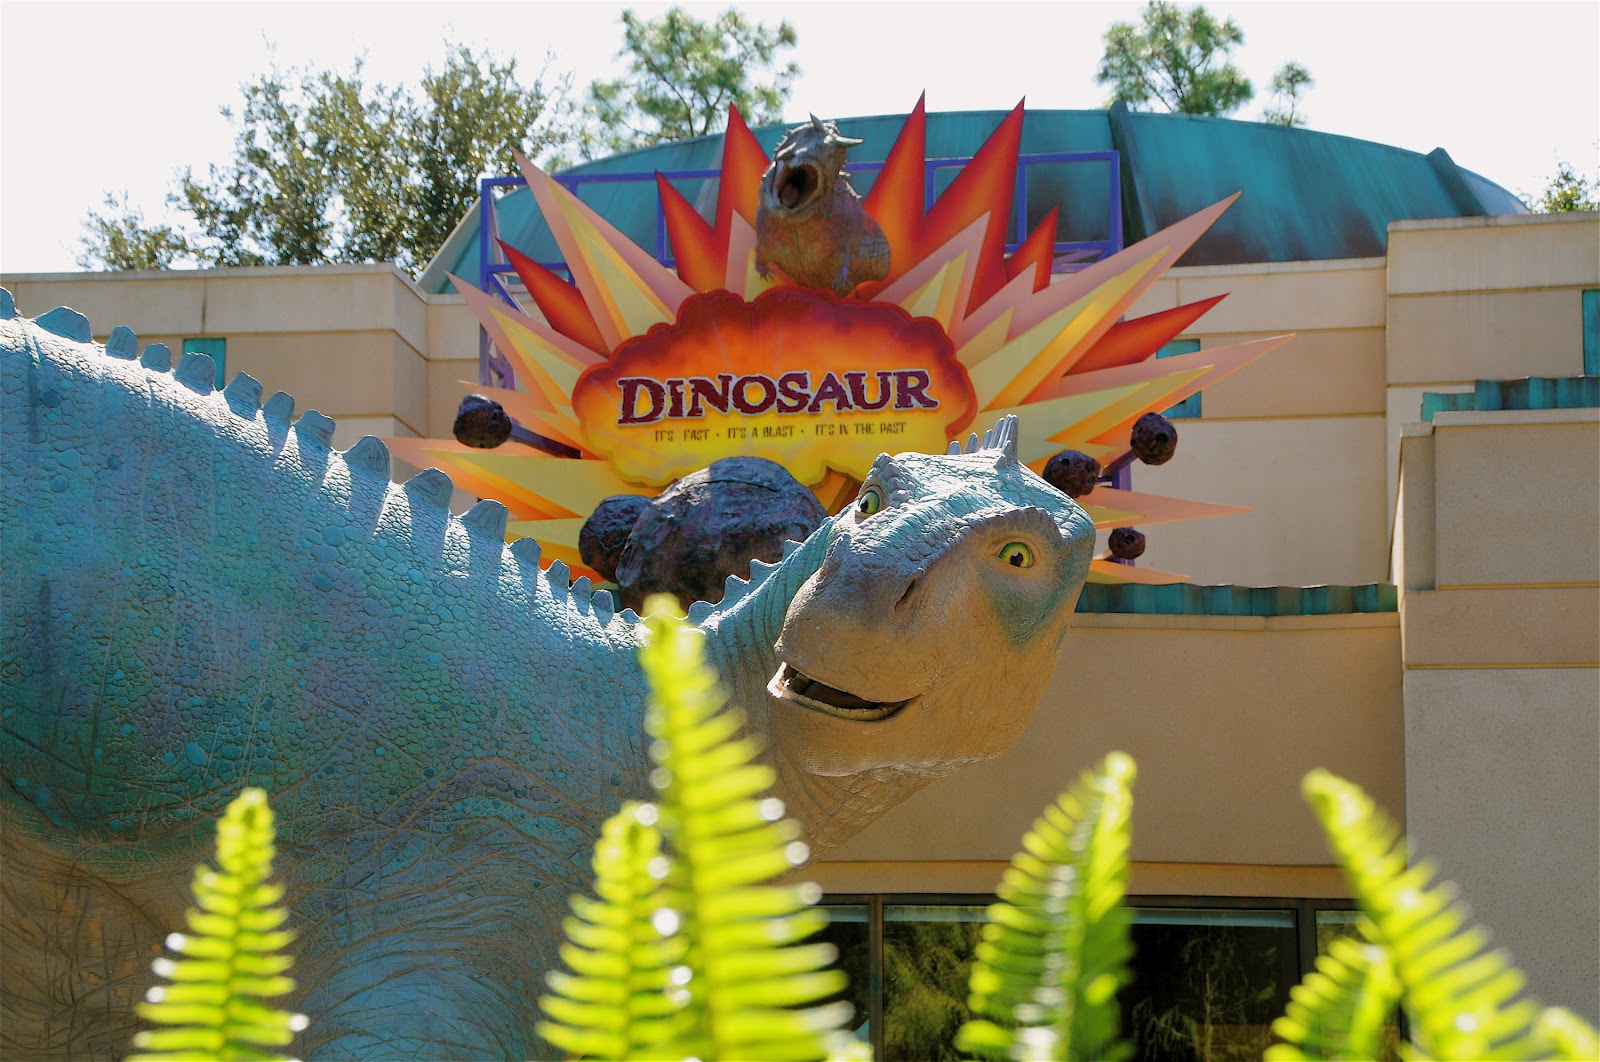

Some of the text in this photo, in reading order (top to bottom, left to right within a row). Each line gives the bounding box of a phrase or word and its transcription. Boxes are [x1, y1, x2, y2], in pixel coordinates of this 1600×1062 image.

[617, 370, 940, 425] DINOSAUR
[655, 421, 907, 441] IT'S FAST IT'S A BLAST IT'S IN THE PAST
